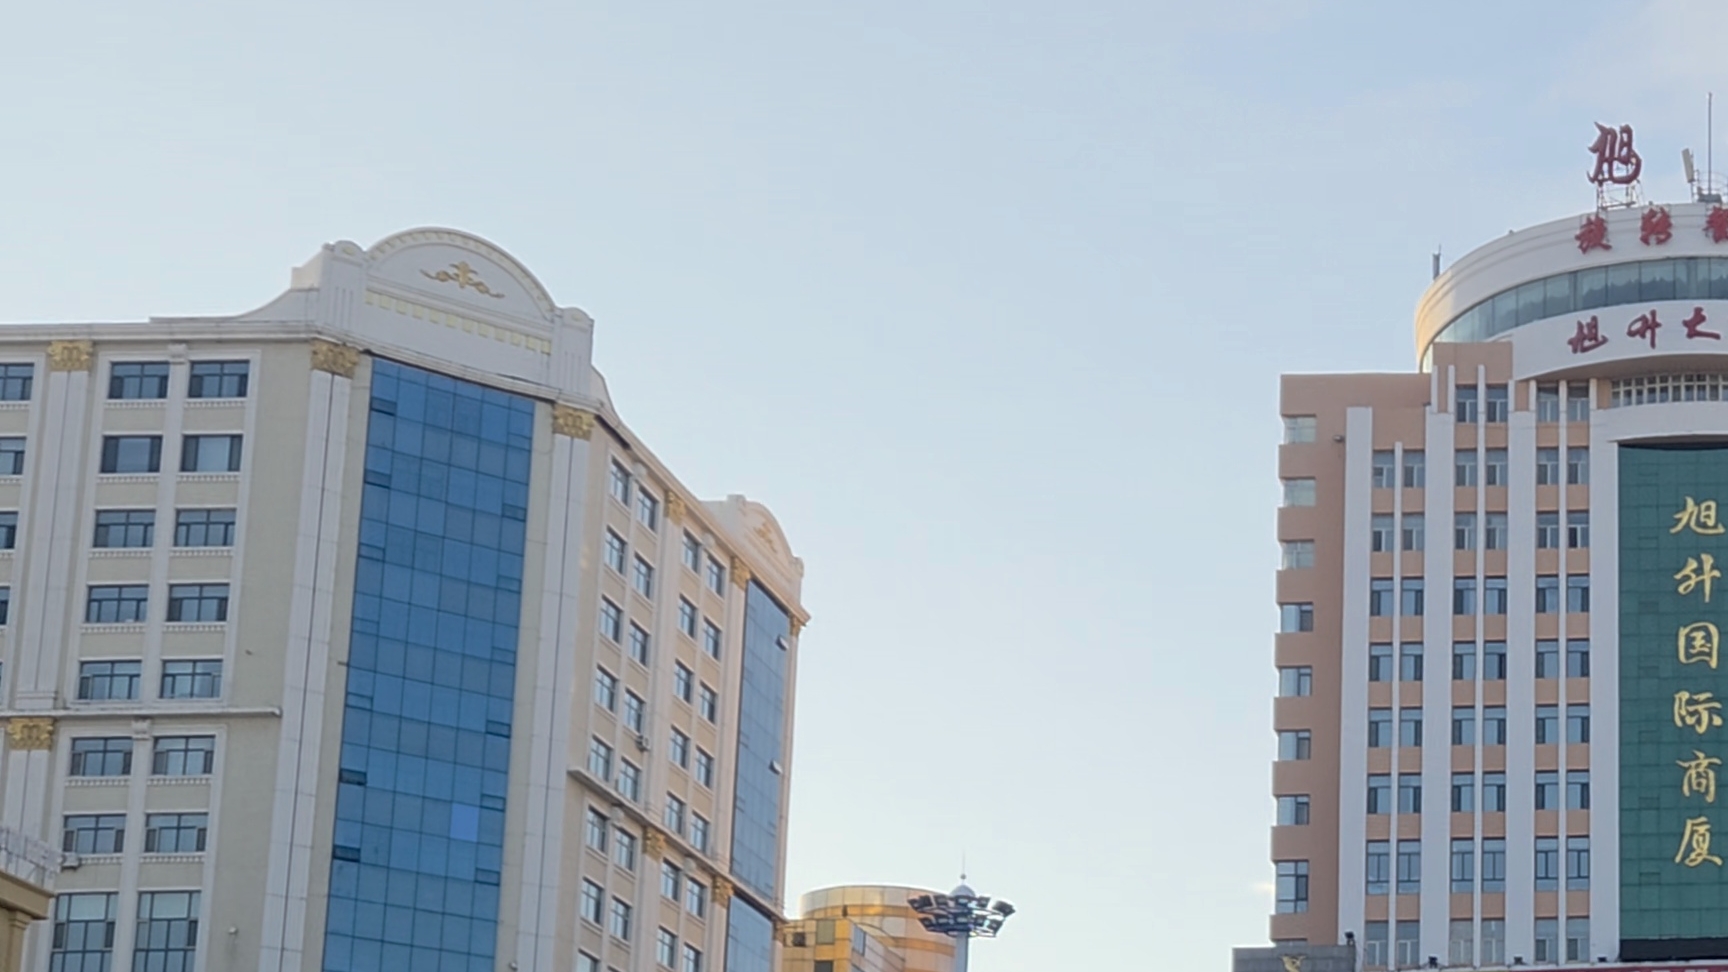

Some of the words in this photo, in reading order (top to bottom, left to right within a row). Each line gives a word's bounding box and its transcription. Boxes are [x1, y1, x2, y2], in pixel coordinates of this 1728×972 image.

[1669, 496, 1726, 868] 旭升国际商厦
